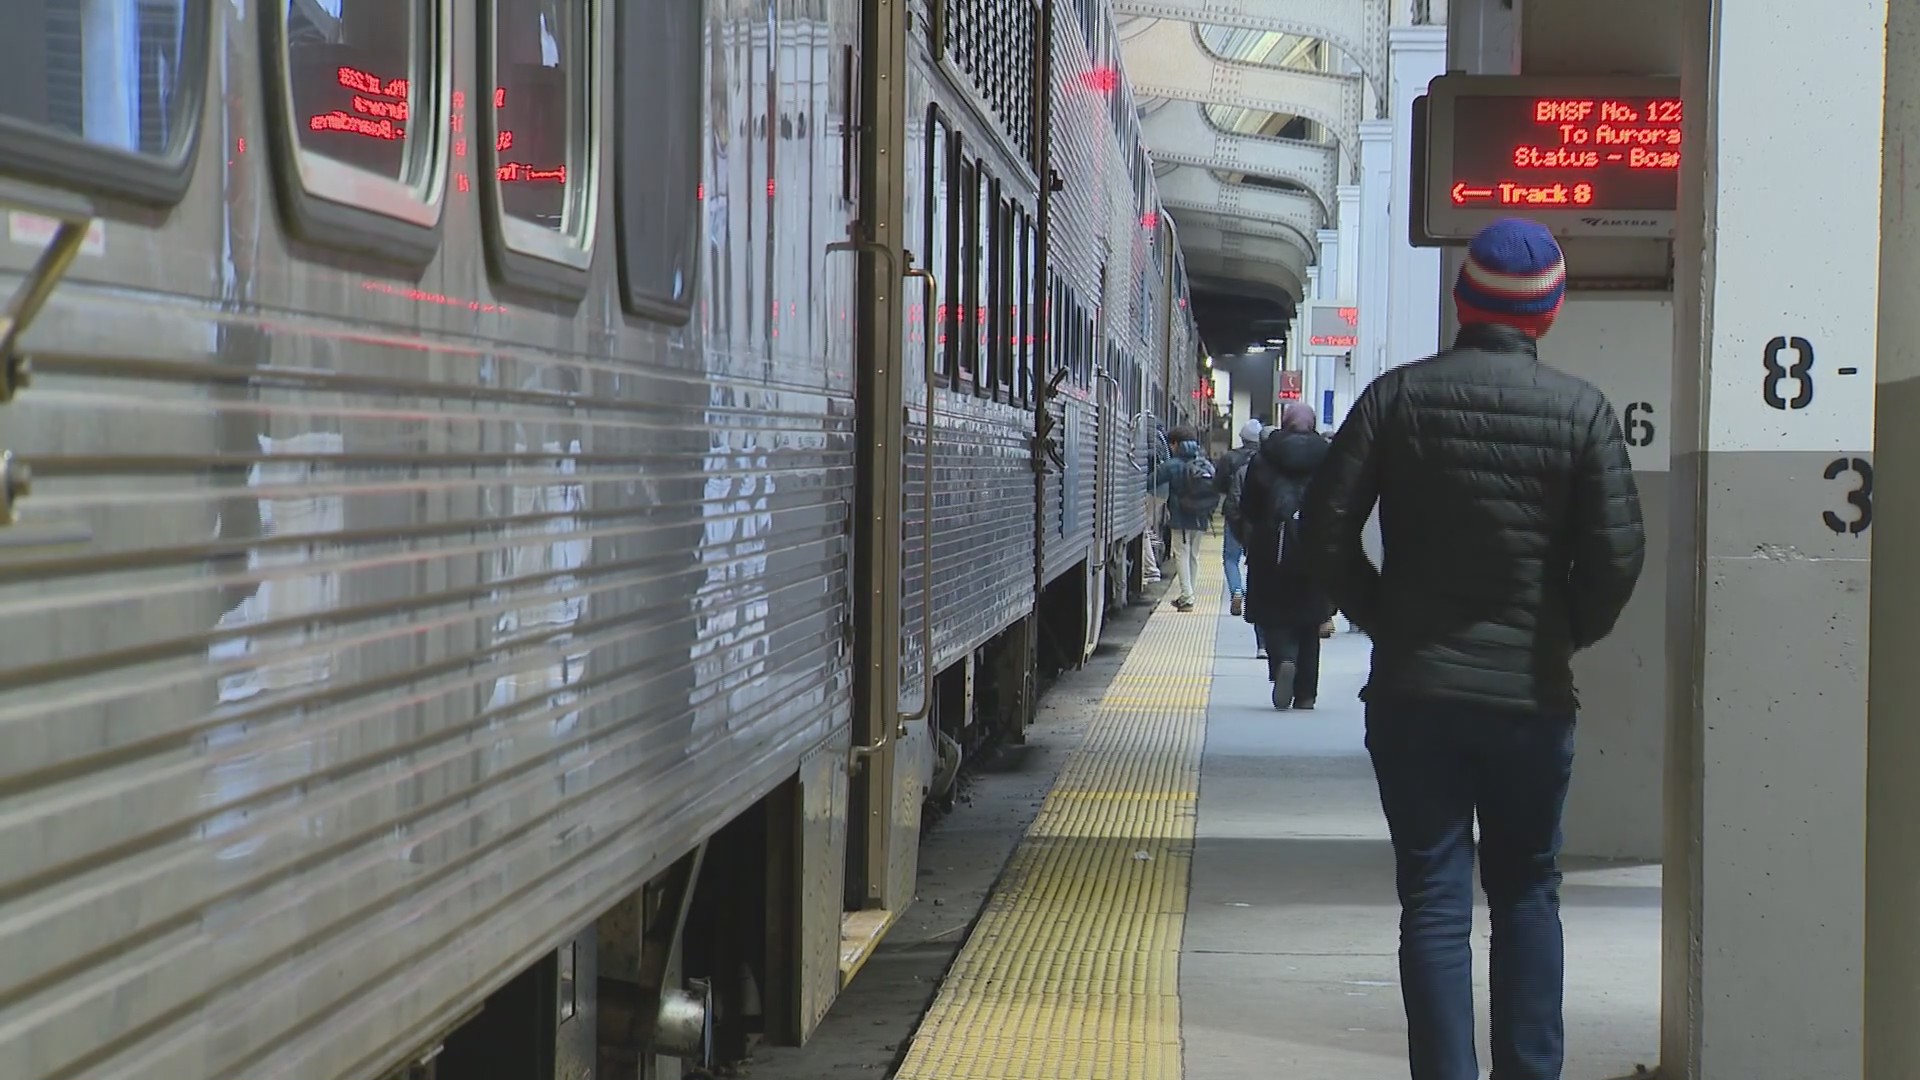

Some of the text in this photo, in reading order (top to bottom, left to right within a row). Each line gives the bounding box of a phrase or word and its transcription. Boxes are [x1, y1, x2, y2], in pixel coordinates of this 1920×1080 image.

[1536, 101, 1594, 121] BNSF
[1601, 101, 1638, 121] No.
[1560, 124, 1681, 144] To Aurora
[1515, 147, 1599, 167] Status
[1499, 184, 1592, 203] Track 8
[1763, 336, 1814, 410] 8
[1624, 402, 1655, 447] 6
[1822, 457, 1873, 535] 3
